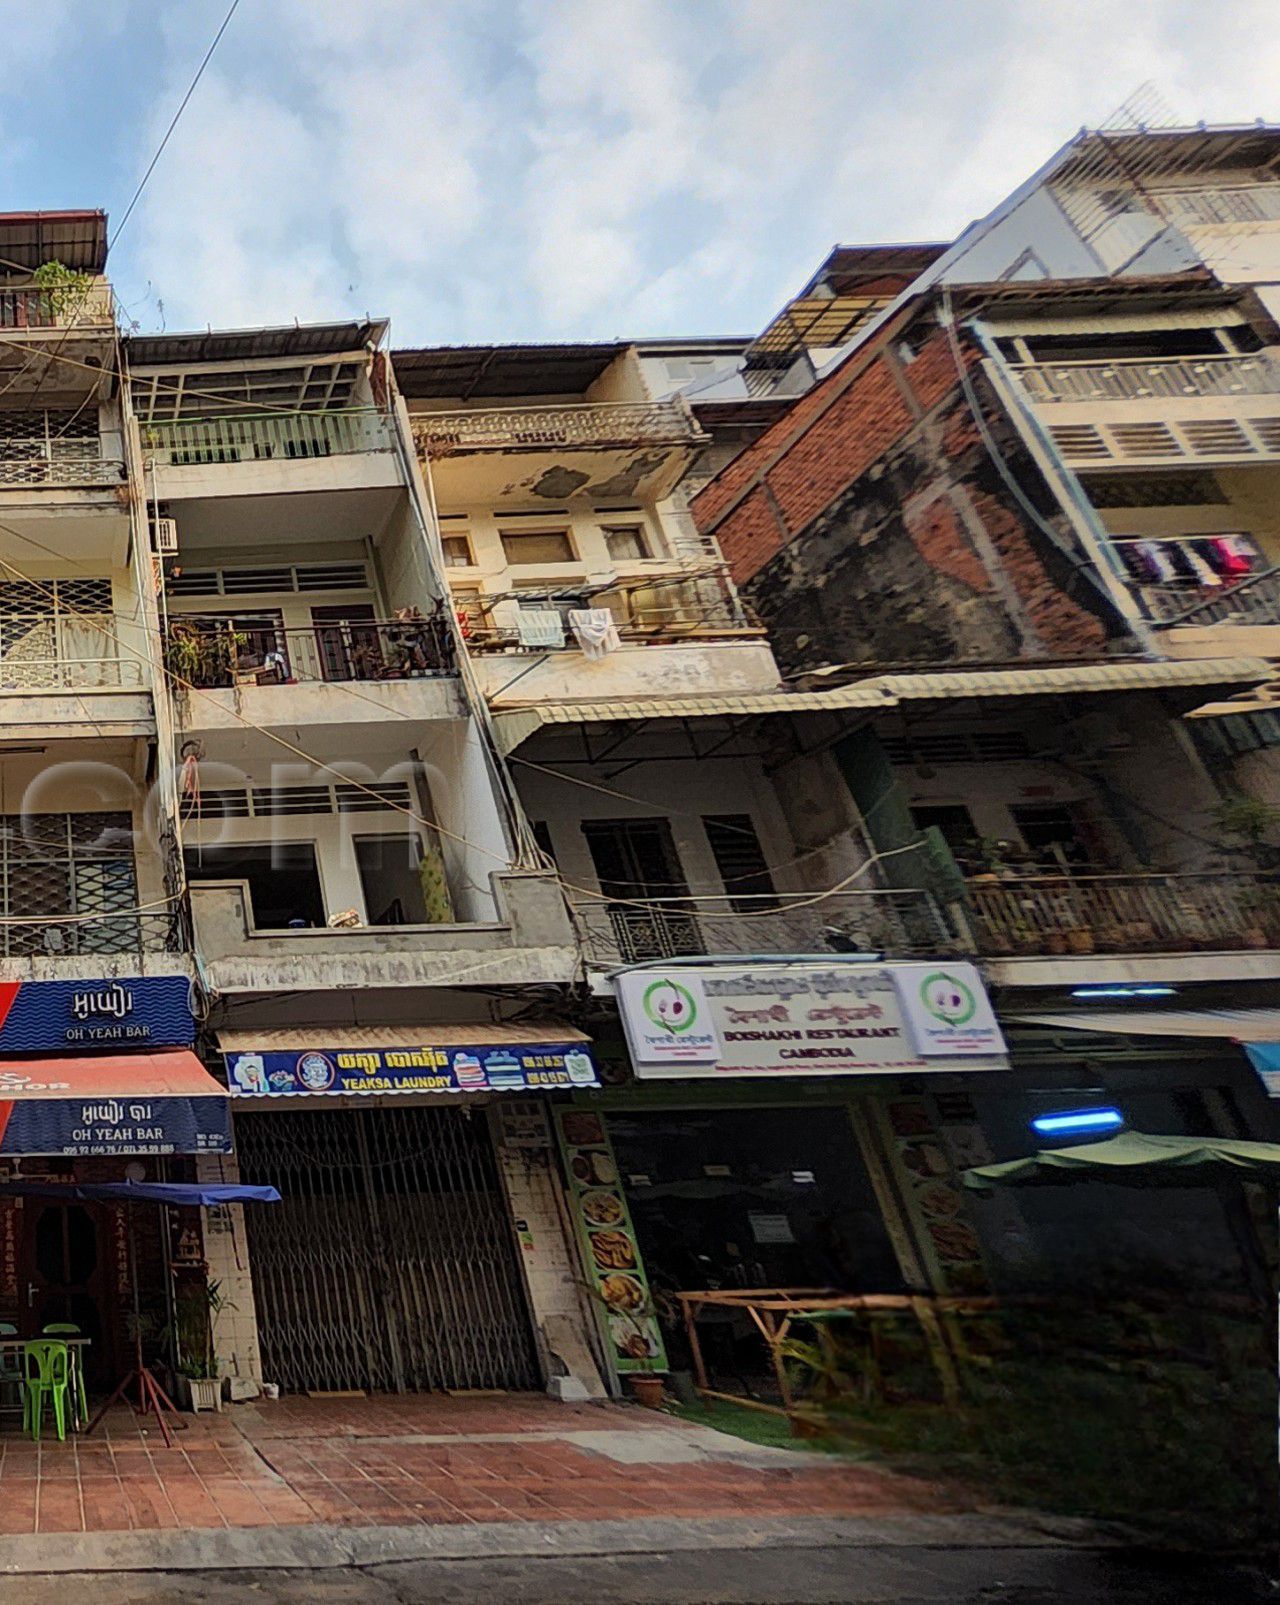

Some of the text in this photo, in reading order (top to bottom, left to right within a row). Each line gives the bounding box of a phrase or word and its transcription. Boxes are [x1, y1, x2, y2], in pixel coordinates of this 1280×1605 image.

[66, 1025, 151, 1040] OH YEAH BAR
[341, 1075, 452, 1090] YEAKSA LAUNDRY
[72, 1127, 163, 1141] OH YEAH BAR
